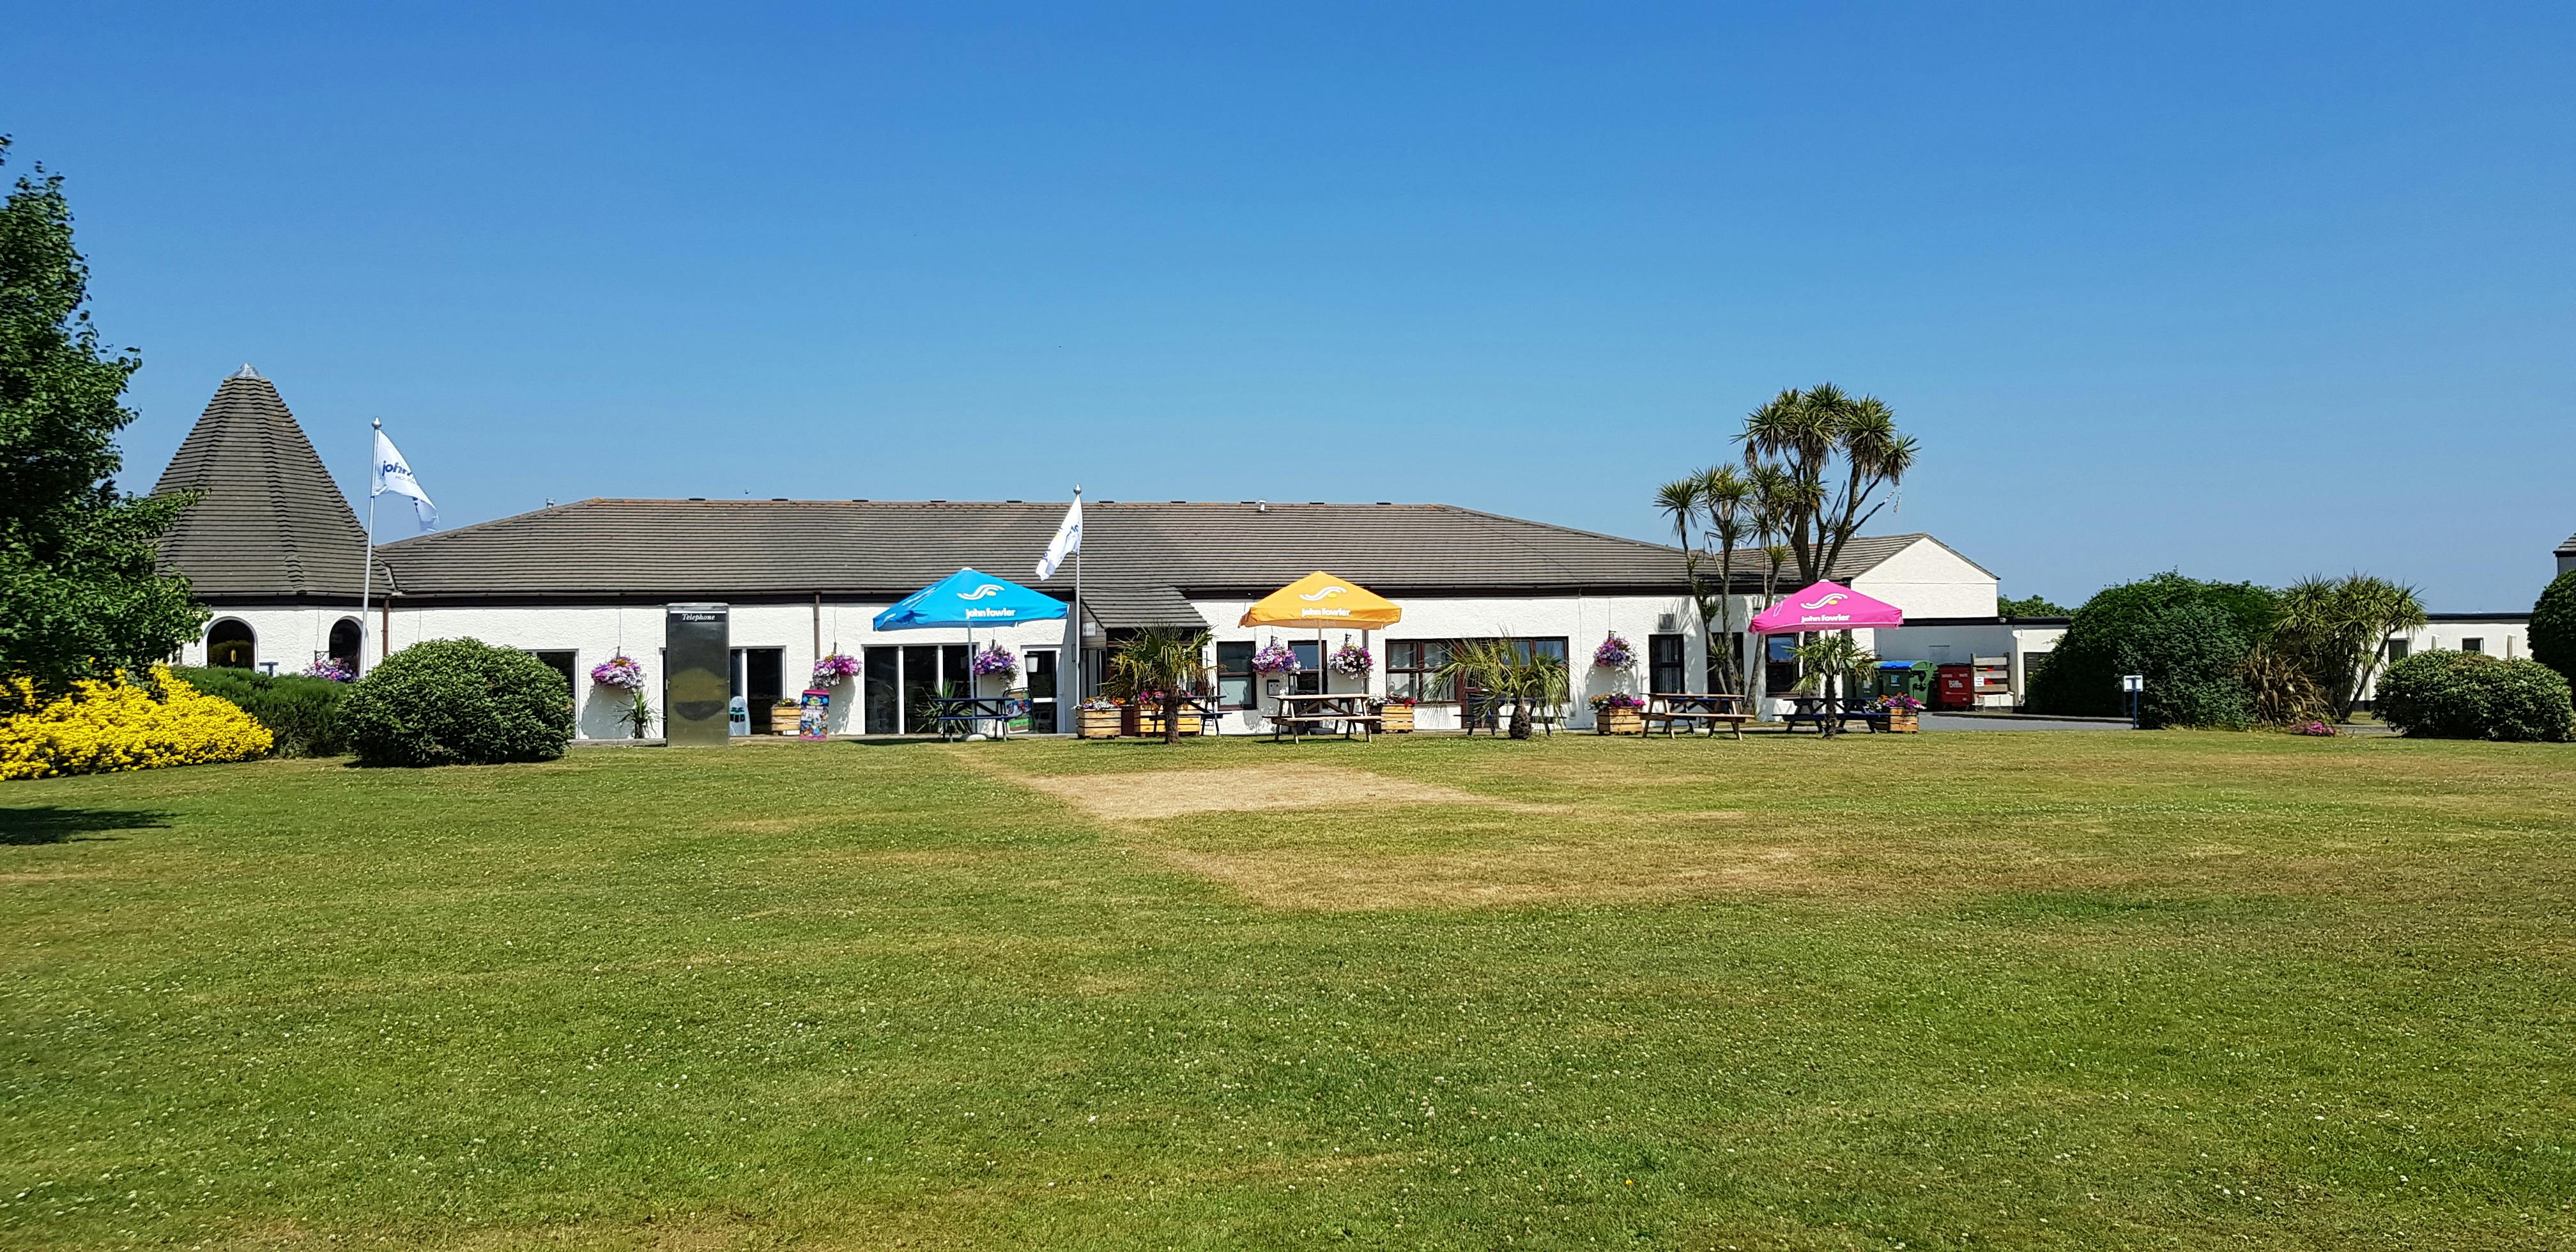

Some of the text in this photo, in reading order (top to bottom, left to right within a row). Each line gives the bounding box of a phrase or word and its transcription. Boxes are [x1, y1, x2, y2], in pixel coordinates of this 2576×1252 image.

[965, 607, 1016, 620] john fowler
[1301, 607, 1351, 618] john fowler
[1801, 613, 1851, 623] john fowler
